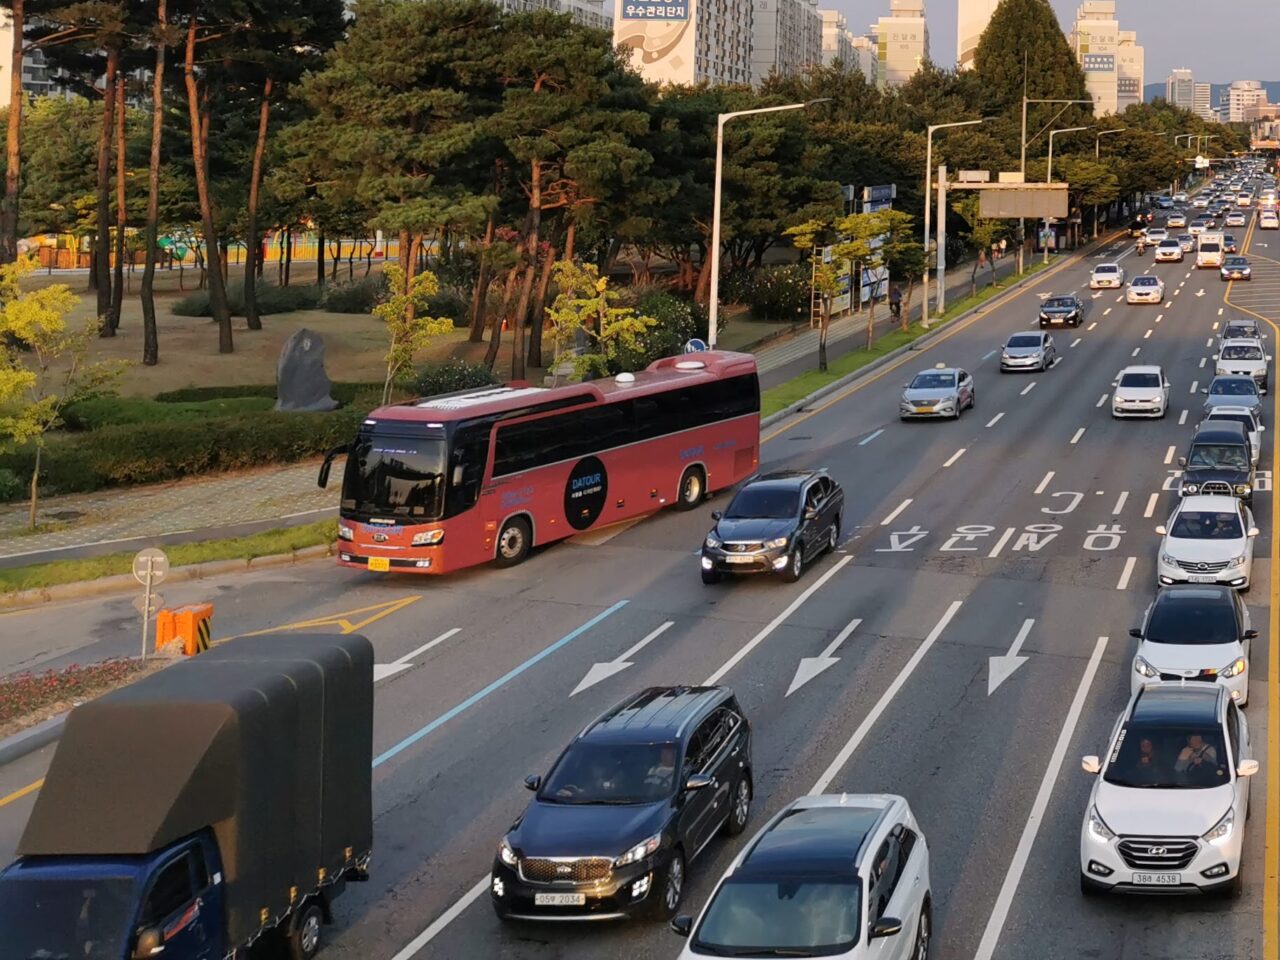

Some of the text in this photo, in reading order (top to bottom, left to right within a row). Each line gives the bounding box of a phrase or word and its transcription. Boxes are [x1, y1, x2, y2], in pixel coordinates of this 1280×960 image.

[626, 5, 685, 17] 우수관리단지
[572, 472, 601, 490] DATOUR
[1156, 874, 1177, 884] 4538
[559, 895, 581, 904] 2034
